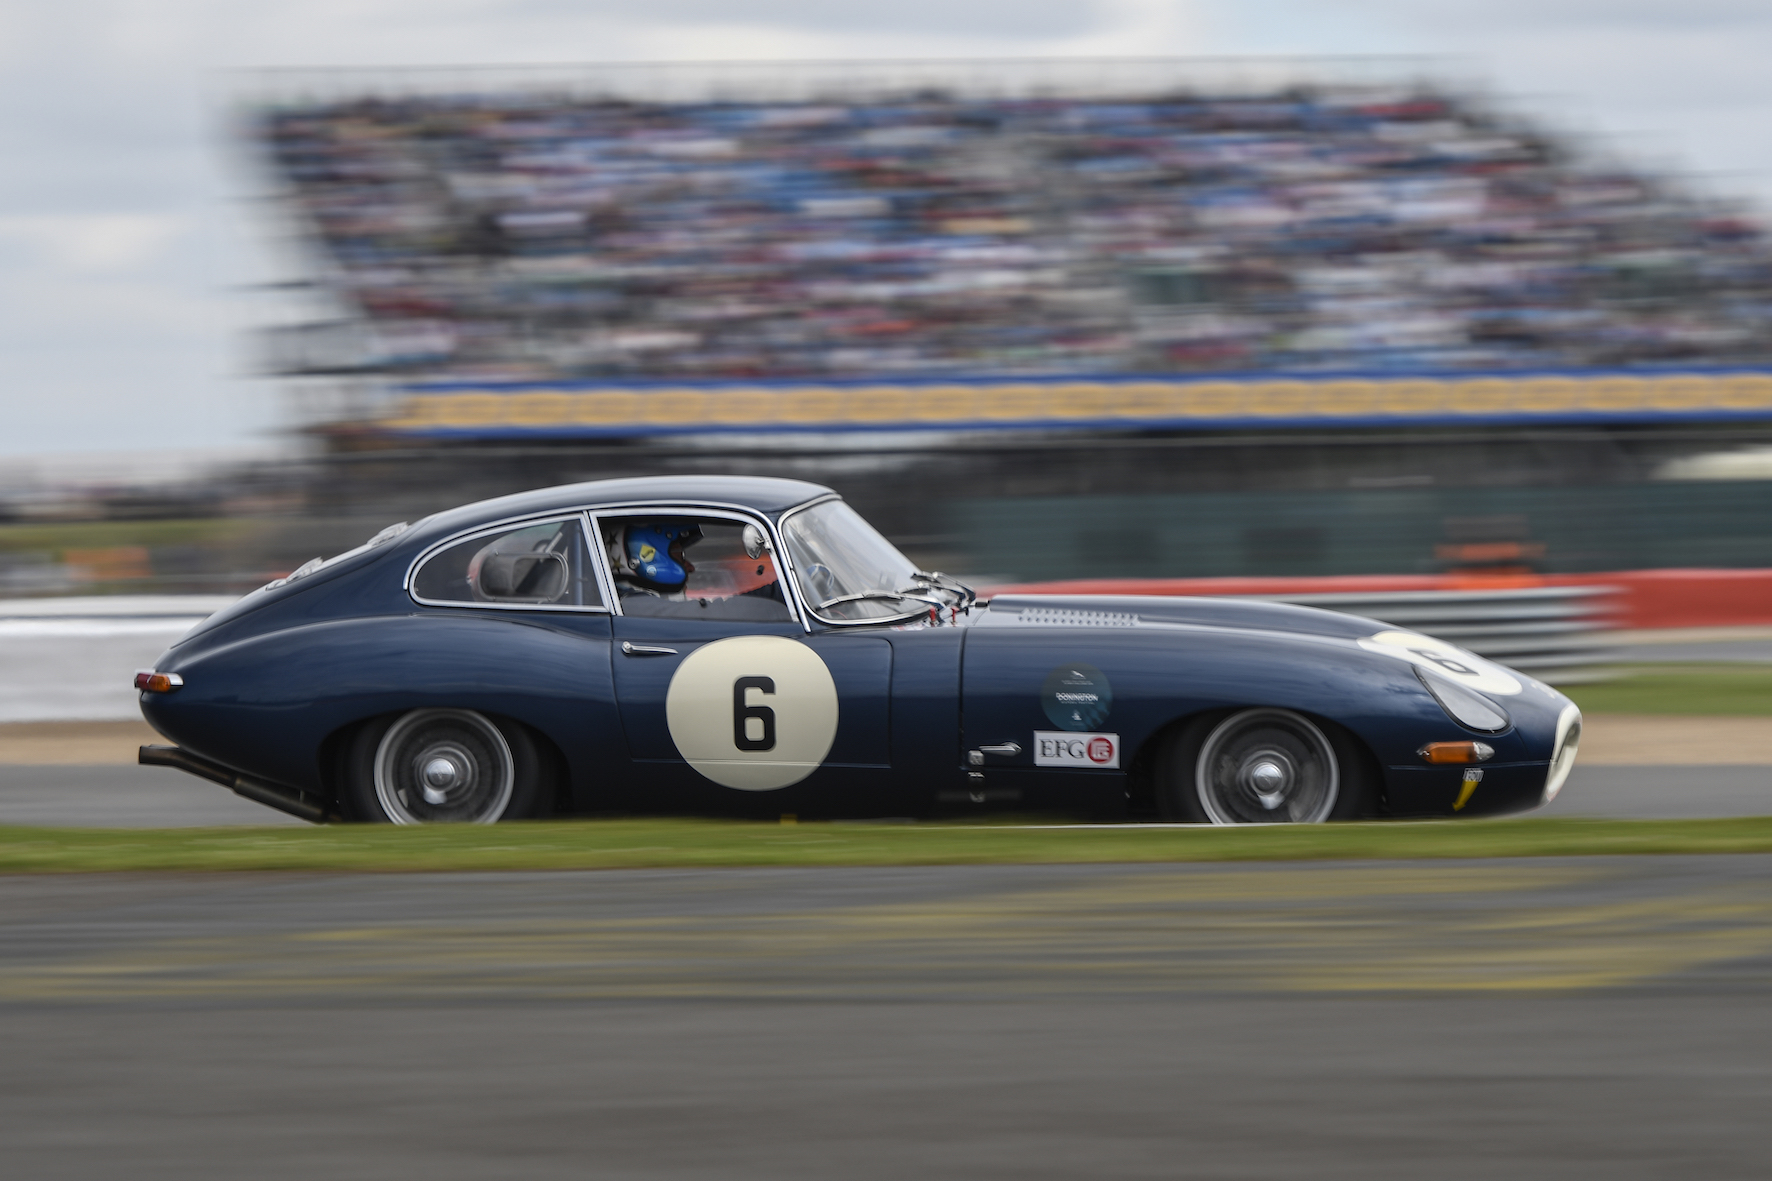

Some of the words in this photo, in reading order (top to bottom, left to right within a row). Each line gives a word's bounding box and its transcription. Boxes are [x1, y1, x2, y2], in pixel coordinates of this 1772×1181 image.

[1406, 648, 1480, 676] 6
[1055, 692, 1099, 702] DONINGTON
[733, 675, 776, 752] 6
[1039, 738, 1086, 759] EFG
